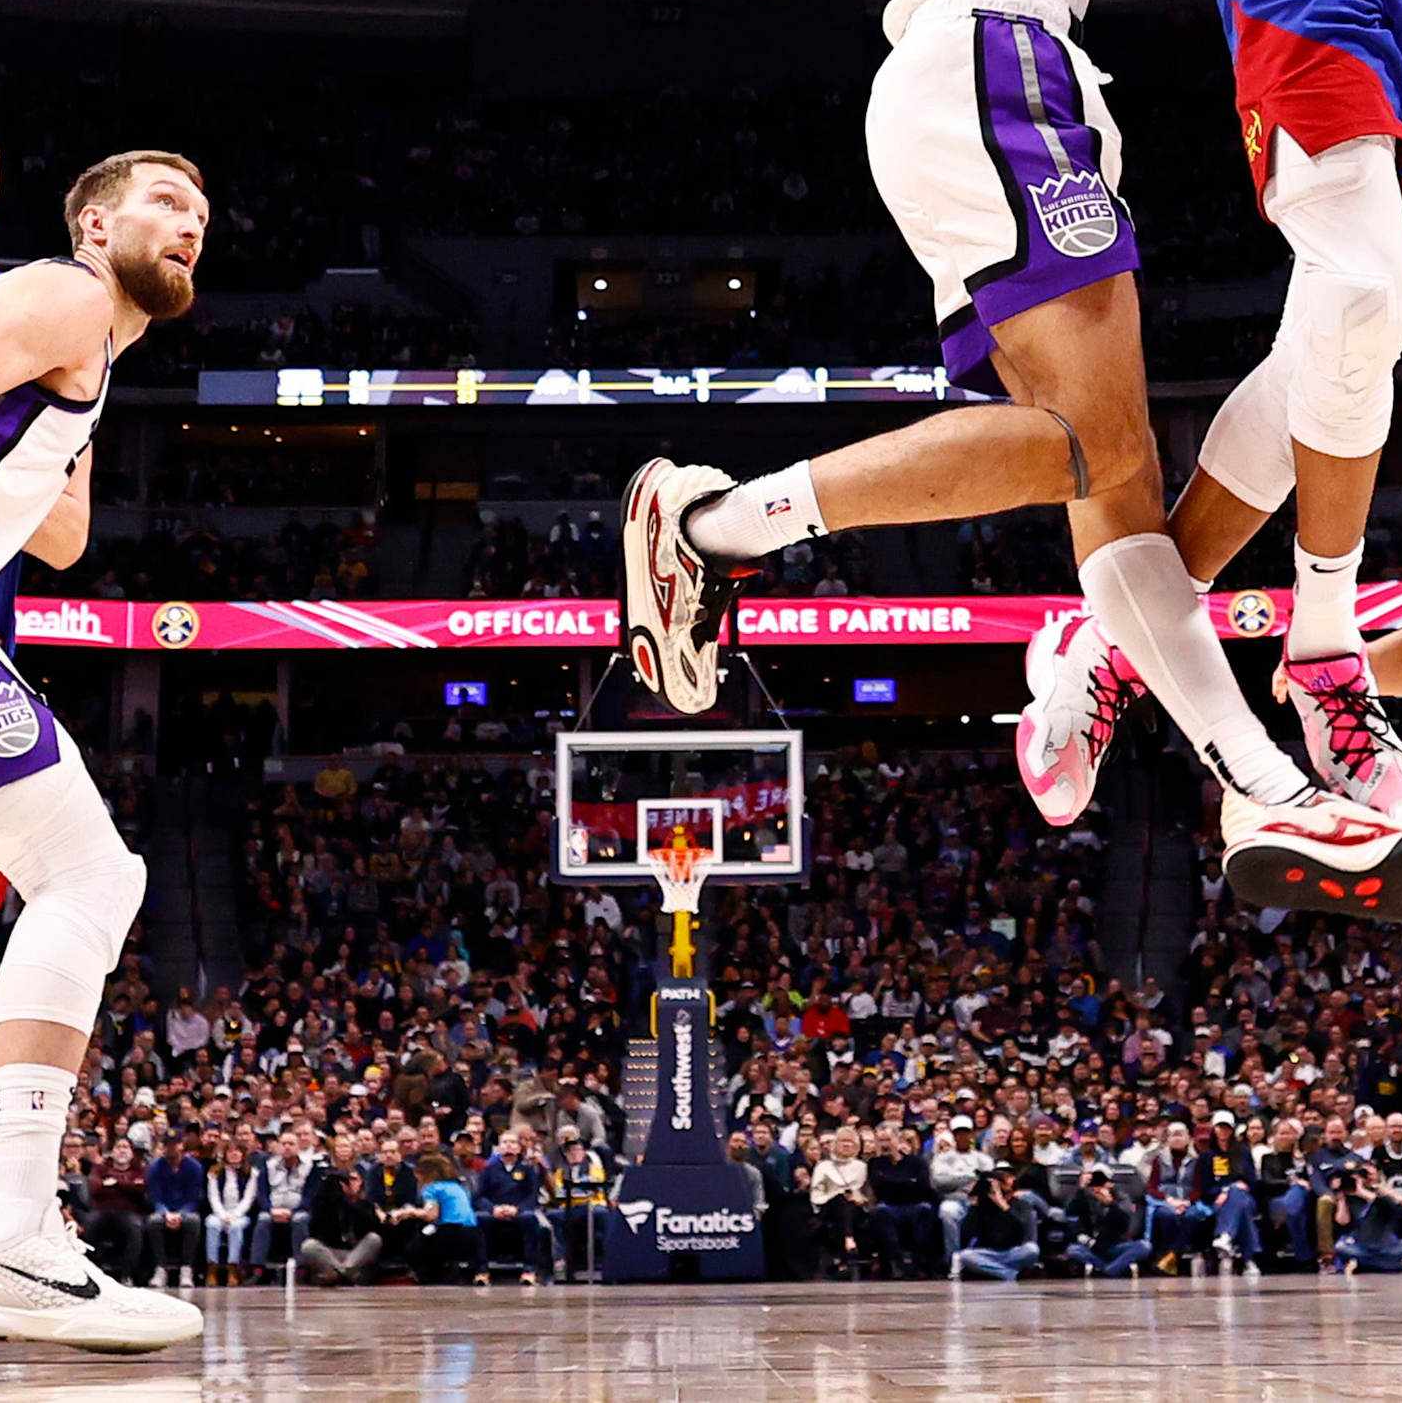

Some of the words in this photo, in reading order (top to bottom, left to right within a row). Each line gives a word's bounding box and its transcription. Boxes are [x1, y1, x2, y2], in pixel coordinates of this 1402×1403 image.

[1045, 204, 1113, 232] KINGS
[449, 610, 595, 636] OFFICIAL
[737, 609, 818, 634] CARE
[829, 607, 971, 633] PARTNER
[661, 987, 700, 1000] PATH
[671, 1022, 692, 1130] Southwest
[655, 1207, 755, 1234] Fanatics
[656, 1235, 740, 1251] Sportsbook
